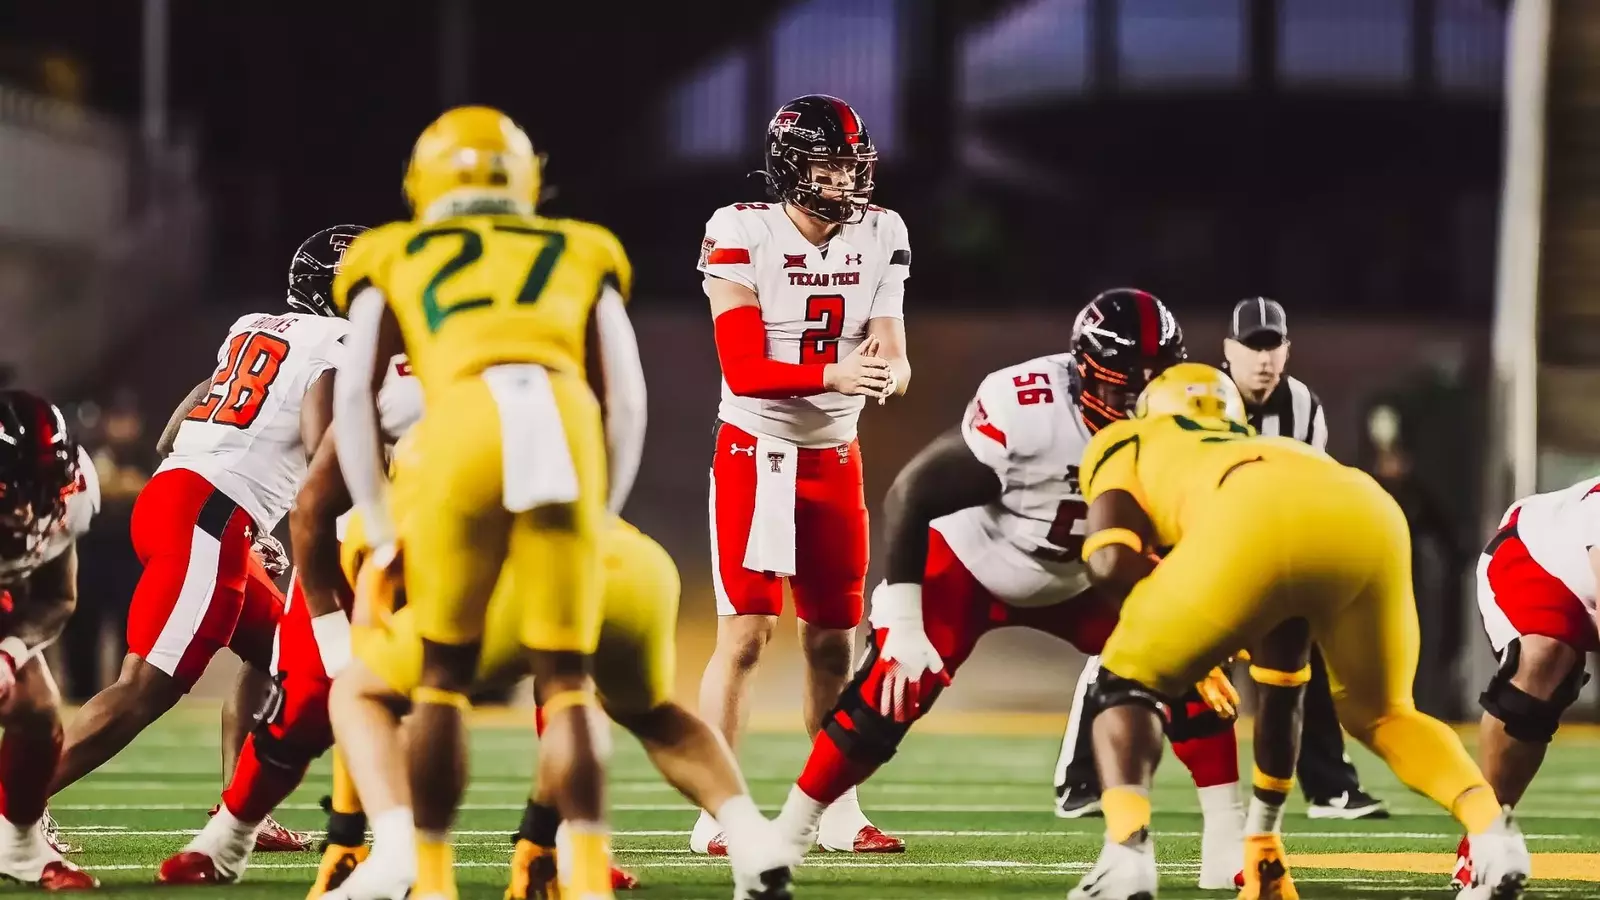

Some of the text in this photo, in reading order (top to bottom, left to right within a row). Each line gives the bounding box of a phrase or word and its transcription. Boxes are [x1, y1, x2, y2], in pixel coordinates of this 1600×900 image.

[406, 228, 567, 334] 27
[788, 272, 860, 286] TEXAS TECH
[799, 293, 845, 365] 2
[186, 330, 290, 430] 28
[1013, 372, 1054, 406] 56
